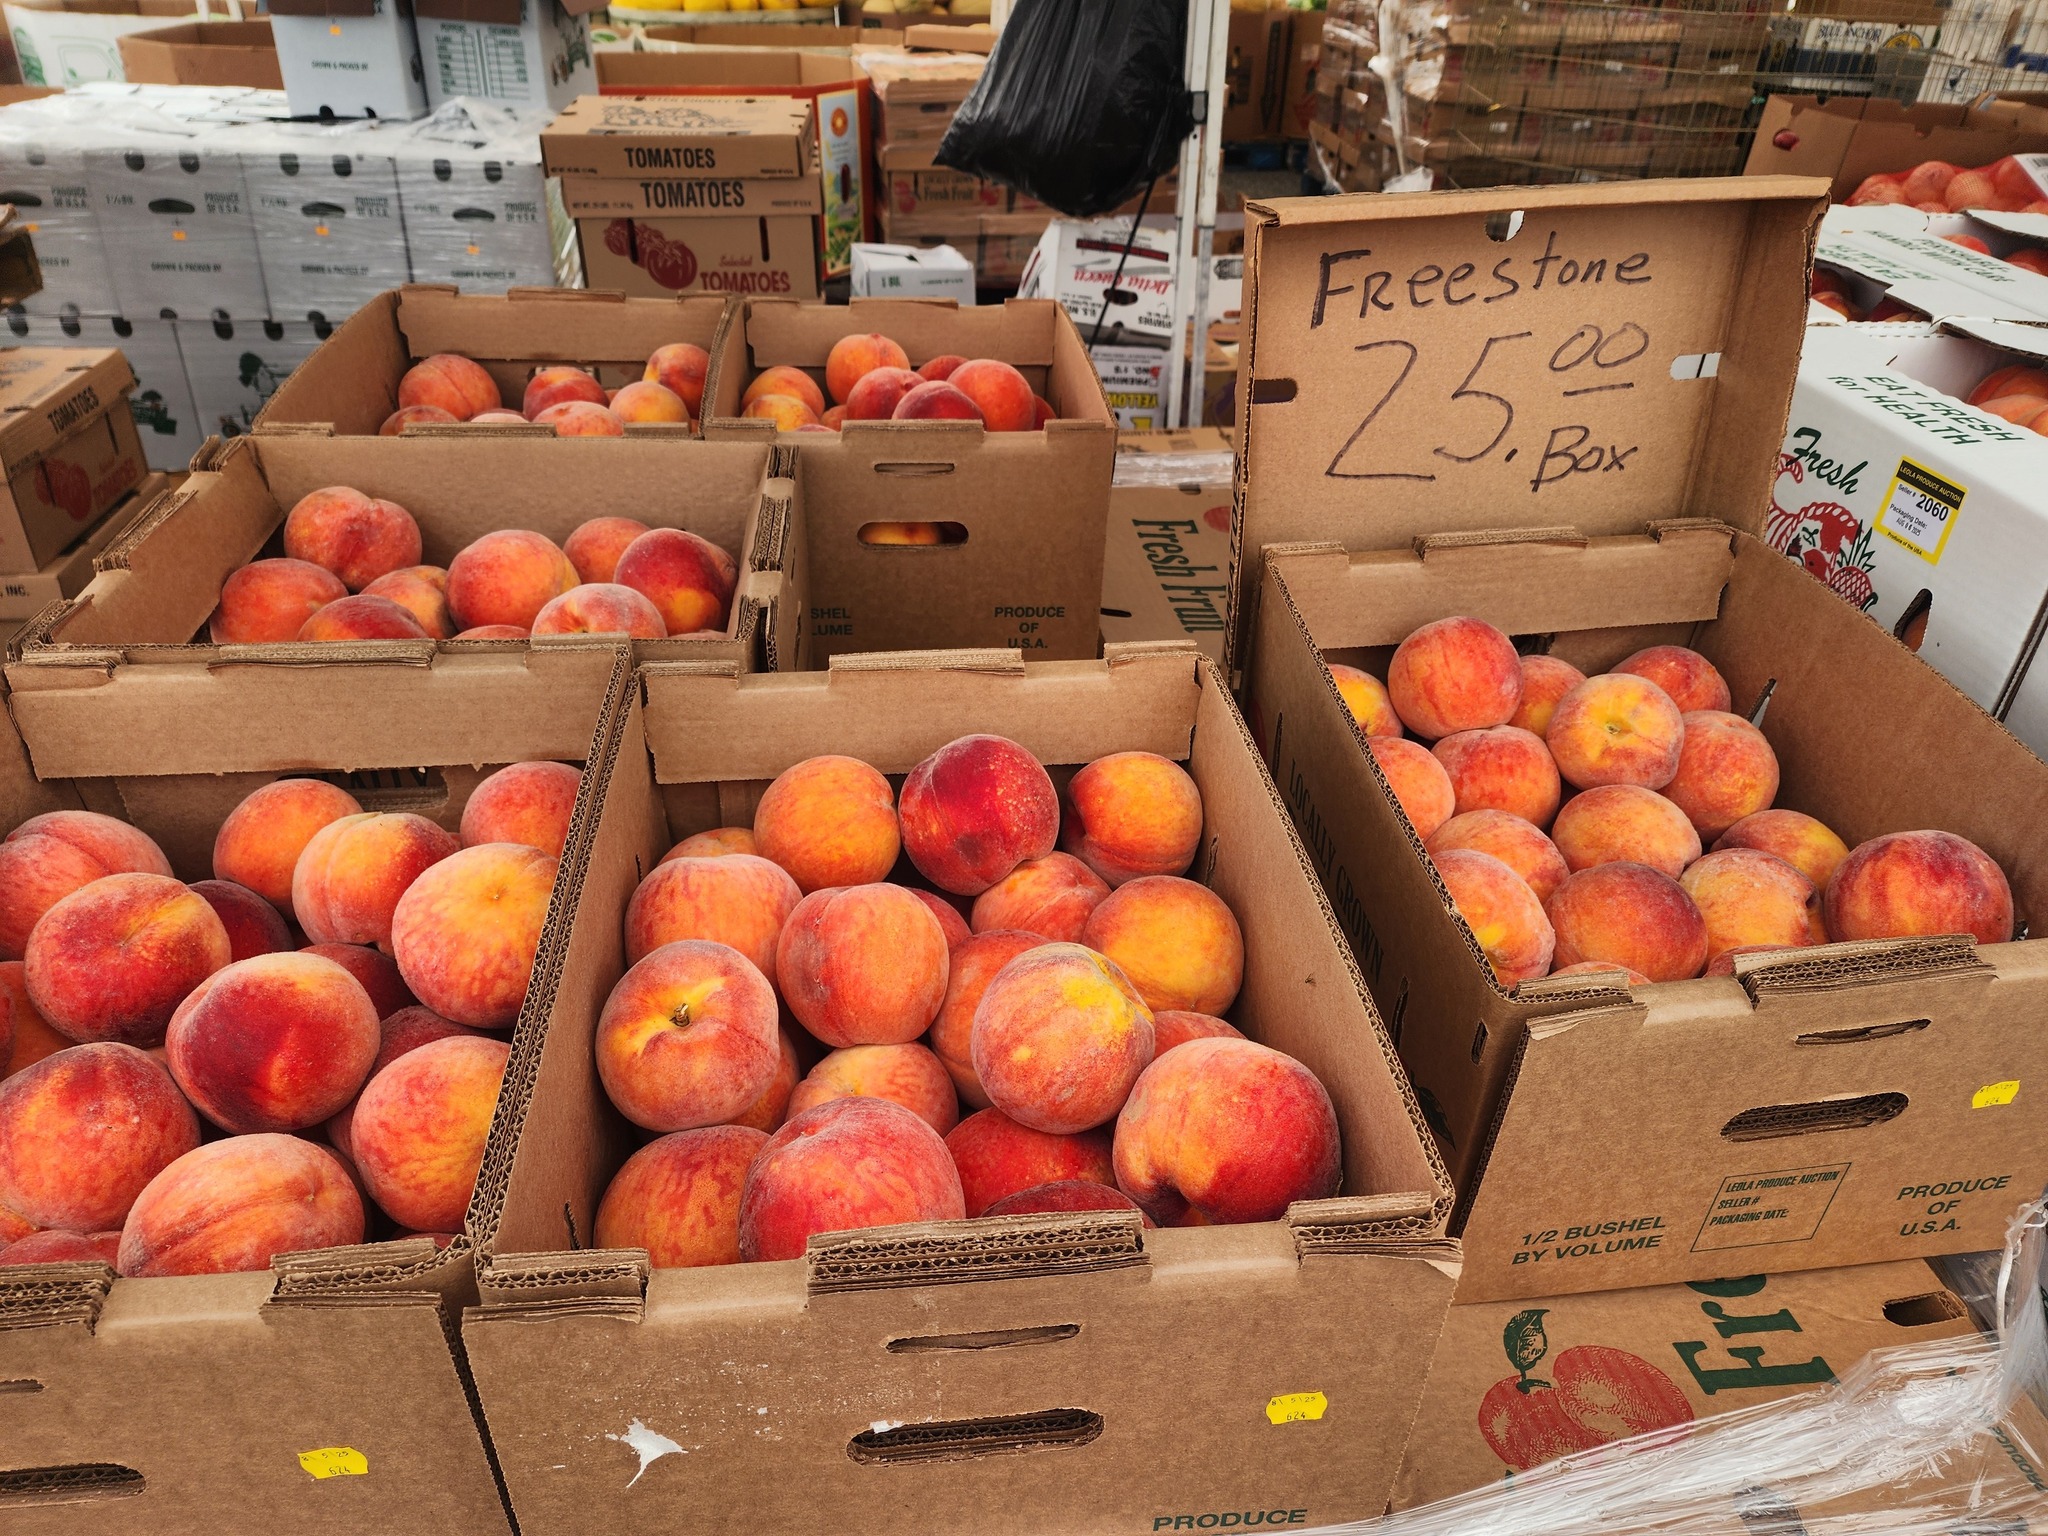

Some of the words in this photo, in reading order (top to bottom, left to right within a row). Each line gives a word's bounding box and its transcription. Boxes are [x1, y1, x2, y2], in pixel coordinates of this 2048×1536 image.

[624, 147, 716, 169] TOMATOES
[204, 192, 239, 202] PRODUCE
[640, 180, 745, 209] TOMATOES
[924, 186, 948, 200] Fresh
[951, 186, 973, 200] Fruit
[700, 271, 791, 294] TOMATOES
[1128, 275, 1170, 296] Delta
[1100, 376, 1149, 386] PREMIUM
[47, 385, 100, 434] TOMATOES
[1827, 375, 1870, 392] for
[1864, 395, 1983, 445] HEALTH
[1864, 376, 1928, 398] EAT
[1915, 400, 2026, 442] FRESH
[1530, 425, 1638, 493] Box
[1785, 427, 1869, 496] Fresh
[1900, 466, 1916, 479] LEOLA
[1916, 473, 1940, 492] PRODUCE
[1939, 486, 1962, 503] AUCTION
[1889, 503, 1914, 522] Packaging
[1898, 484, 1912, 496] Seller
[1916, 493, 1949, 521] 2060
[1896, 517, 1905, 527] AUG
[1131, 518, 1219, 577] Fresh
[1887, 531, 1903, 544] Produce
[1913, 545, 1923, 556] USA
[810, 607, 851, 620] SHEL
[994, 606, 1065, 619] PRODUCE
[1018, 622, 1040, 634] OF
[1007, 637, 1049, 650] U.S.A.
[1288, 757, 1338, 881] LOCALLY
[1335, 864, 1385, 986] GROWN
[1725, 1181, 1754, 1193] LEOLA
[1754, 1175, 1799, 1191] PRODUCE
[1798, 1171, 1841, 1185] AUCTION
[1896, 1175, 2013, 1201] PRODUCE
[1717, 1197, 1751, 1210] SELLER
[1751, 1196, 1761, 1205] #
[1926, 1200, 1962, 1216] OF
[1709, 1211, 1763, 1227] PACKAGING
[1762, 1208, 1790, 1221] DATE:
[1899, 1218, 1962, 1237] U.S.A.
[1522, 1229, 1559, 1246] 1/2
[1563, 1216, 1667, 1240] BUSHEL
[1511, 1248, 1549, 1265] BY
[1555, 1234, 1664, 1260] VOLUME
[1286, 1411, 1307, 1421] 624
[1987, 1425, 2048, 1492] PRODUCE
[328, 1465, 351, 1476] 624
[1152, 1508, 1309, 1532] PRODUCE
